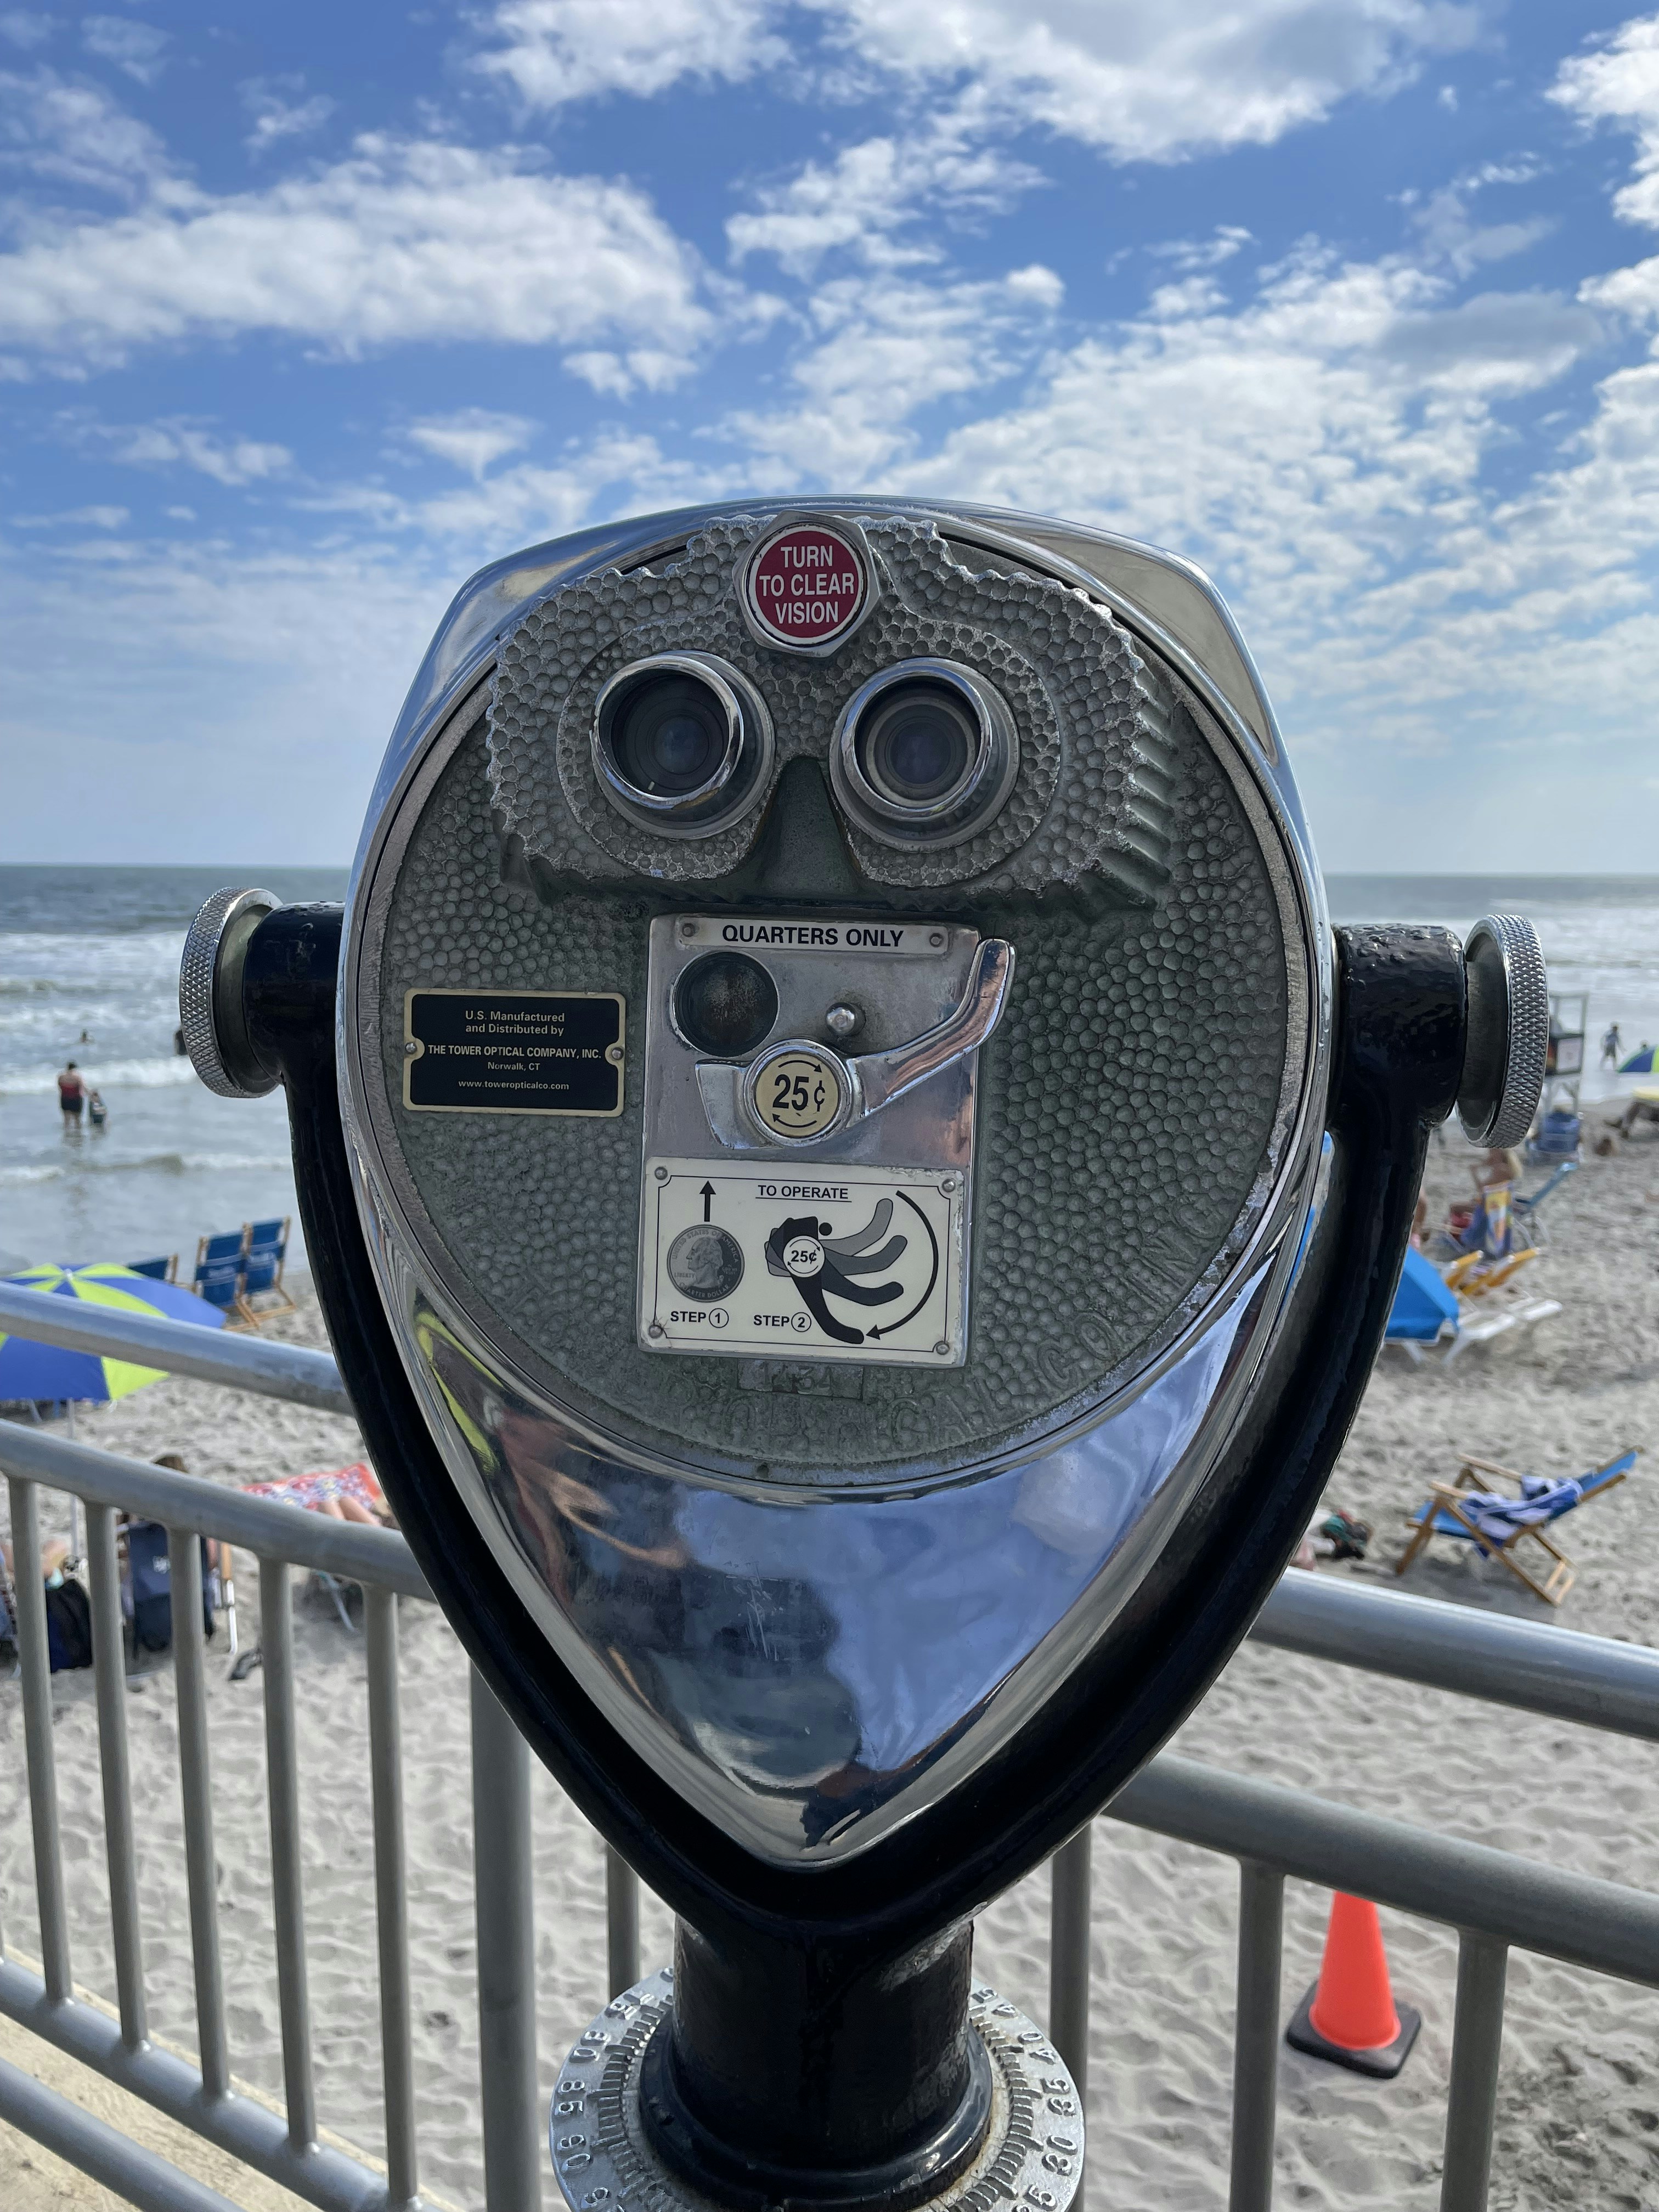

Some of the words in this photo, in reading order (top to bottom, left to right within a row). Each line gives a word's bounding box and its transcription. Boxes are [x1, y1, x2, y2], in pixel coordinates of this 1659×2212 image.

[781, 545, 833, 568] TURN
[759, 574, 785, 597] TO
[791, 572, 855, 596] CLEAR
[775, 601, 839, 624] VISION
[722, 924, 838, 945] QUARTERS
[846, 928, 904, 947] ONLY
[465, 1010, 487, 1020] U.S.
[490, 1011, 565, 1023] Manufactured
[465, 1023, 486, 1033] and
[488, 1024, 548, 1035] Distributed
[550, 1025, 564, 1037] by
[428, 1045, 446, 1055] THE
[448, 1045, 482, 1056] TOWER
[483, 1046, 524, 1057] OPTICAL
[527, 1047, 579, 1059] COMPANY,
[582, 1048, 602, 1059] INC.
[487, 1062, 526, 1071] Norwalk,
[528, 1063, 540, 1071] CT
[458, 1080, 569, 1091] www.toweropticalco.com
[772, 1074, 826, 1112] 25¢
[758, 1184, 777, 1197] TO
[781, 1186, 849, 1200] OPERATE
[791, 1249, 817, 1266] 25¢
[679, 1282, 706, 1298] QUARTER
[707, 1284, 730, 1298] DOLLAR
[670, 1310, 707, 1324] STEP
[753, 1314, 790, 1328] STEP
